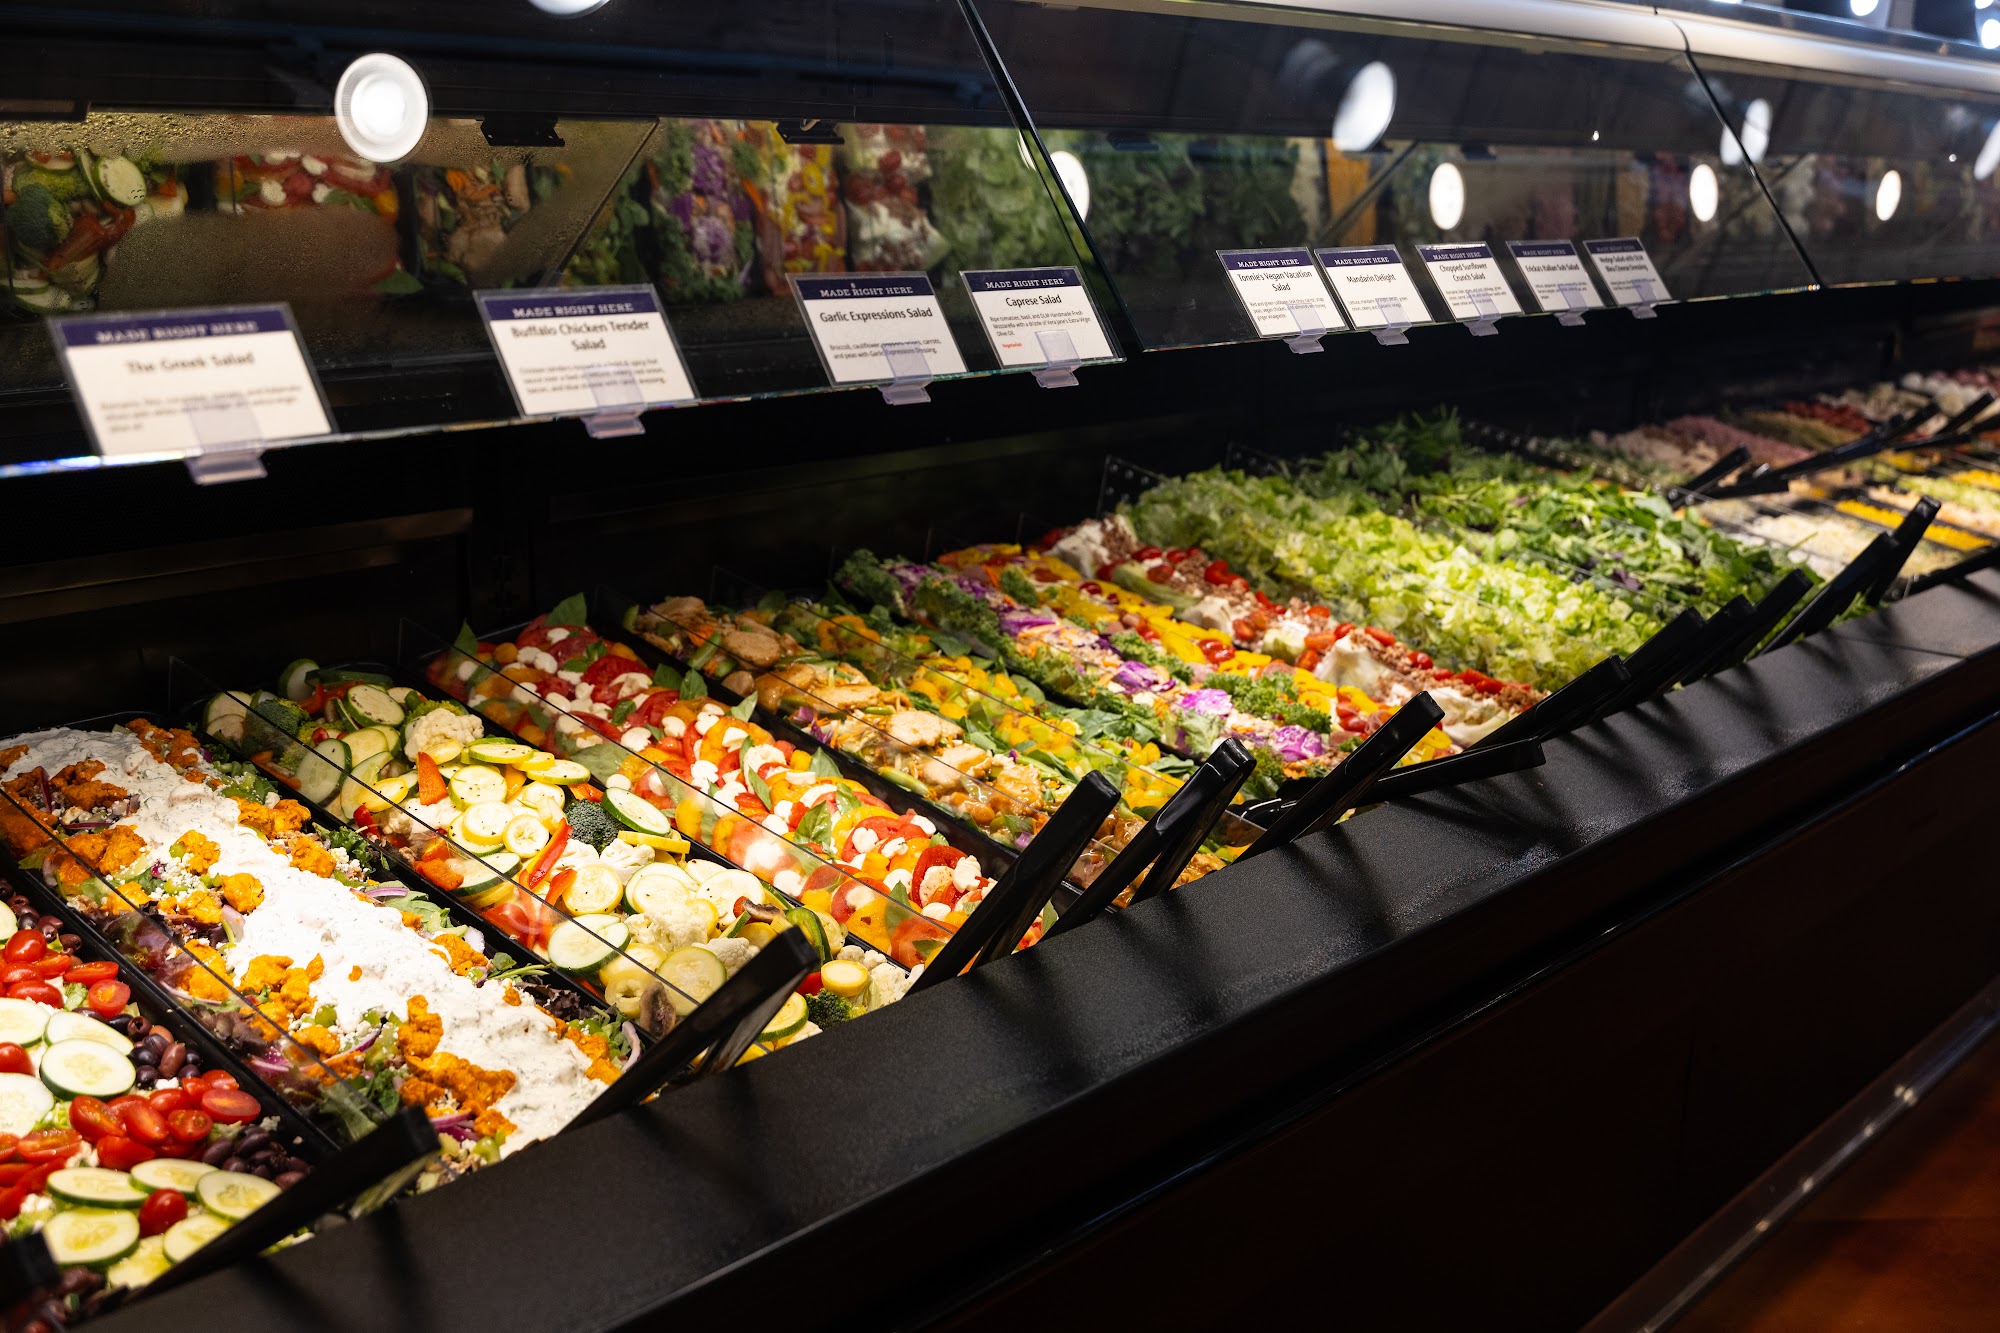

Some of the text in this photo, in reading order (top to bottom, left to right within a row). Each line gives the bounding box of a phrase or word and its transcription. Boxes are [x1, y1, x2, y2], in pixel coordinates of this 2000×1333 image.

[1439, 262, 1488, 273] Chopped Sunflower
[1264, 272, 1285, 281] Vegan
[1283, 270, 1312, 279] Vacation
[1346, 274, 1396, 283] Mandarin Delight
[1453, 274, 1472, 282] Crunch
[986, 280, 1012, 288] MADE
[1013, 279, 1040, 287] RIGHT
[1272, 283, 1291, 291] Salad
[820, 289, 850, 297] MADE
[852, 288, 884, 296] RIGHT
[1005, 294, 1062, 308] Caprese Salad
[512, 303, 634, 318] MADE RIGHT HERE
[820, 307, 933, 323] Garlic Expressions Salad
[96, 321, 258, 343] MADE RIGHT HERE
[511, 320, 649, 338] Buffalo Chicken Tender
[571, 339, 606, 351] Salad
[126, 352, 255, 373] The Greek Salad
